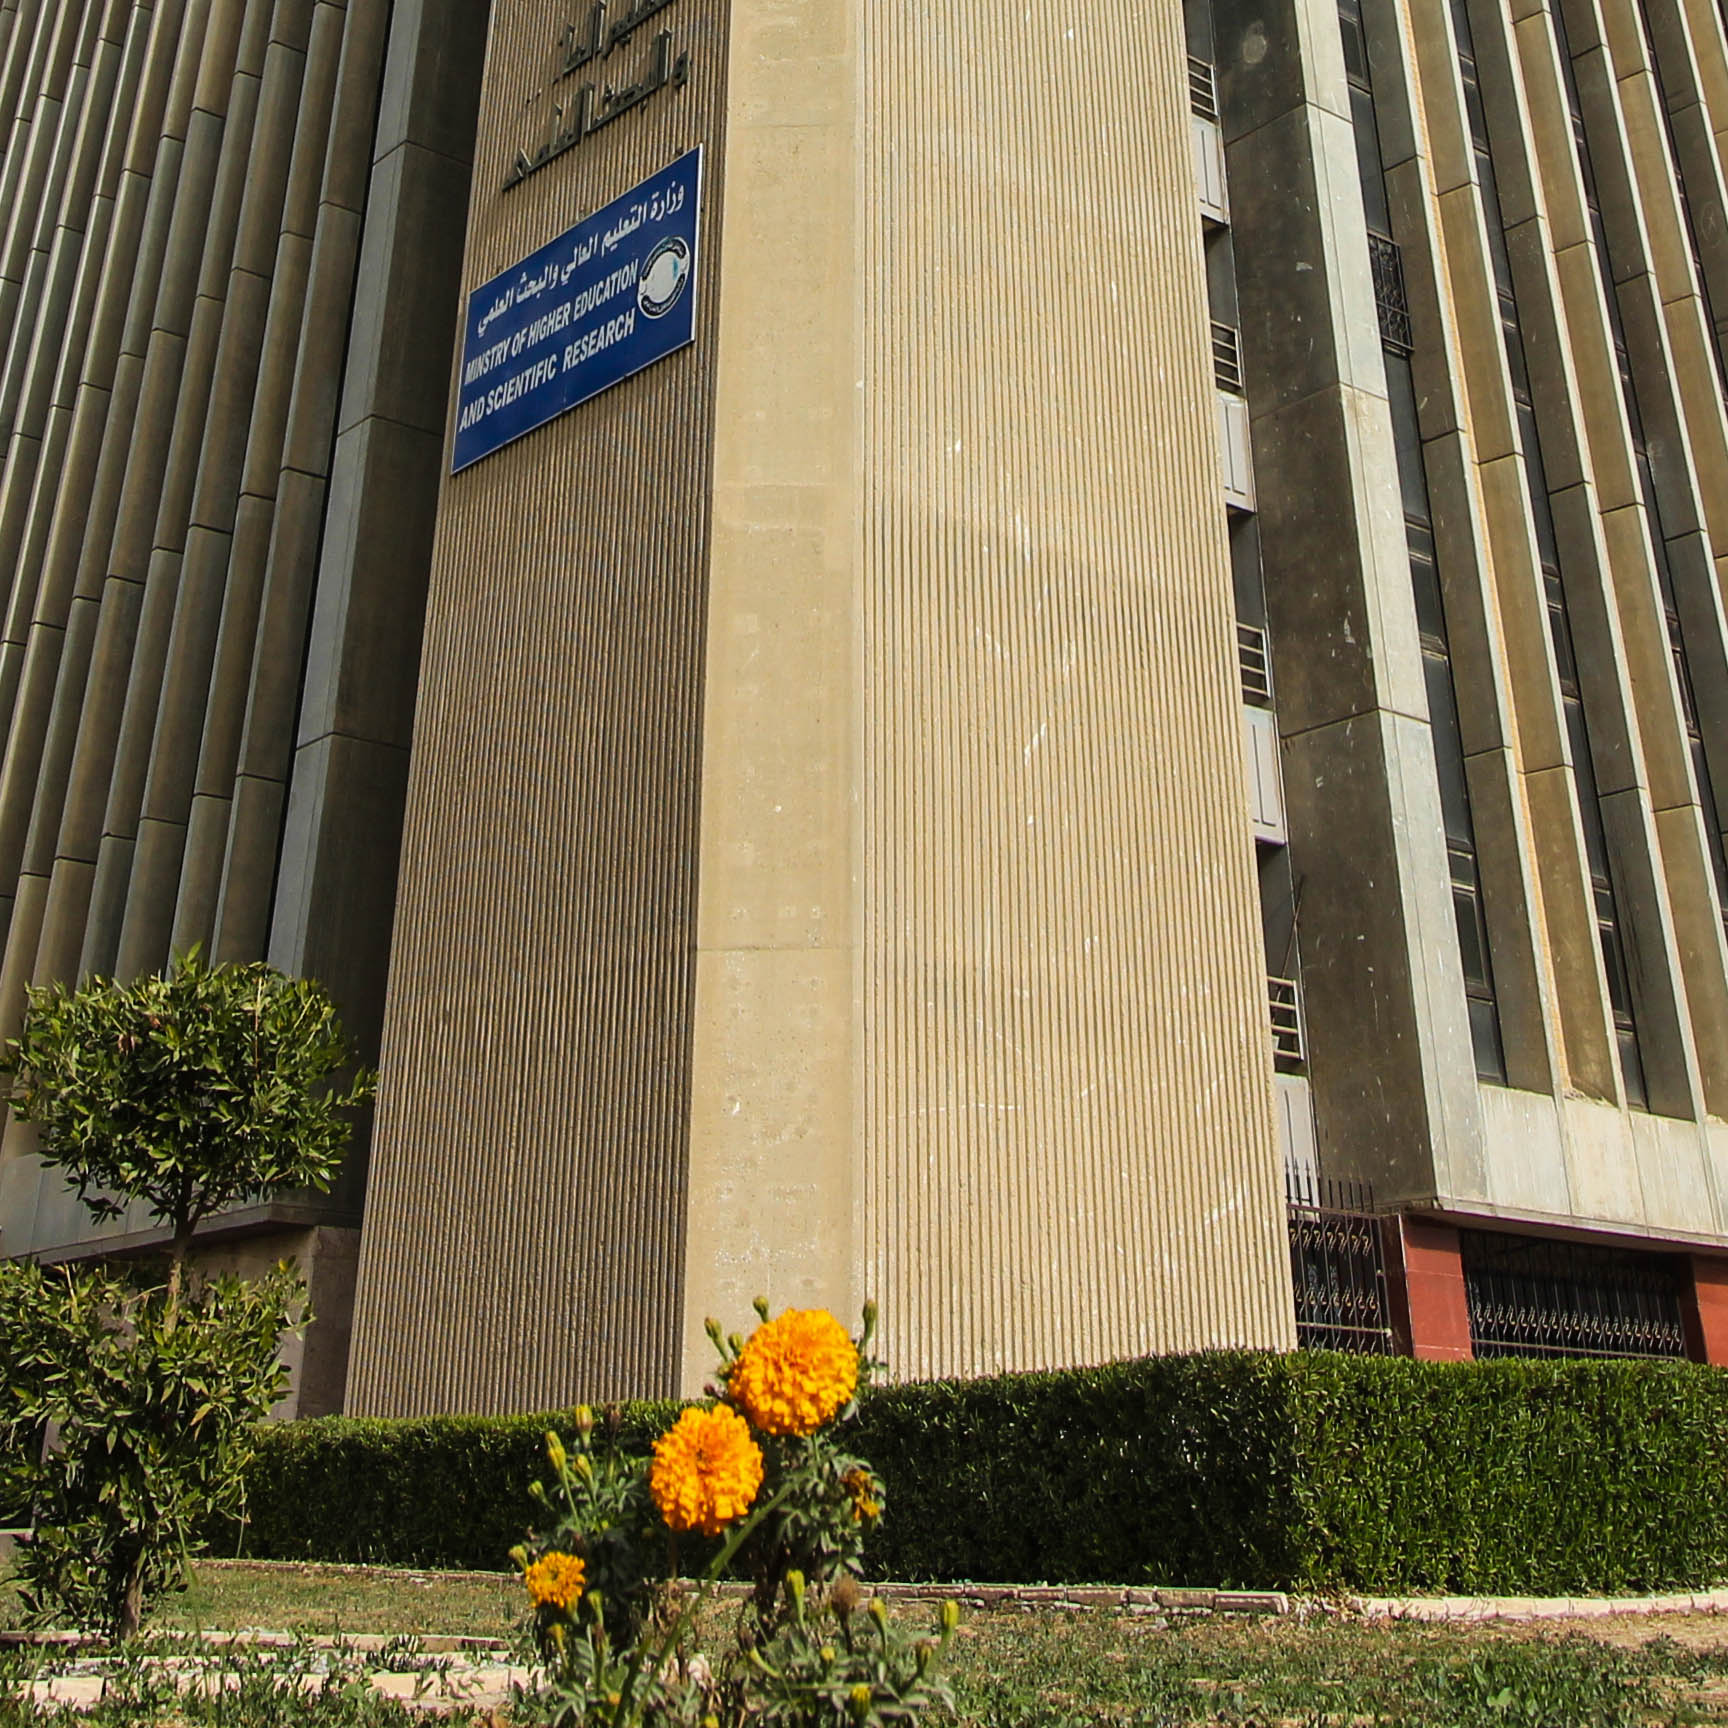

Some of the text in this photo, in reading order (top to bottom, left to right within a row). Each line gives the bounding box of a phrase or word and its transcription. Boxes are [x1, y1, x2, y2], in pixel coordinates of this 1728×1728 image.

[650, 180, 685, 221] وزارة
[602, 201, 647, 258] التعليم
[517, 263, 560, 304] والبحث
[561, 233, 599, 285] العالي
[478, 286, 514, 339] العلمي
[511, 327, 529, 358] OF
[527, 301, 571, 348] HIGHER
[573, 258, 639, 322] EDUCATION
[459, 307, 636, 432] AND SCIENTIFIC RESEARCH
